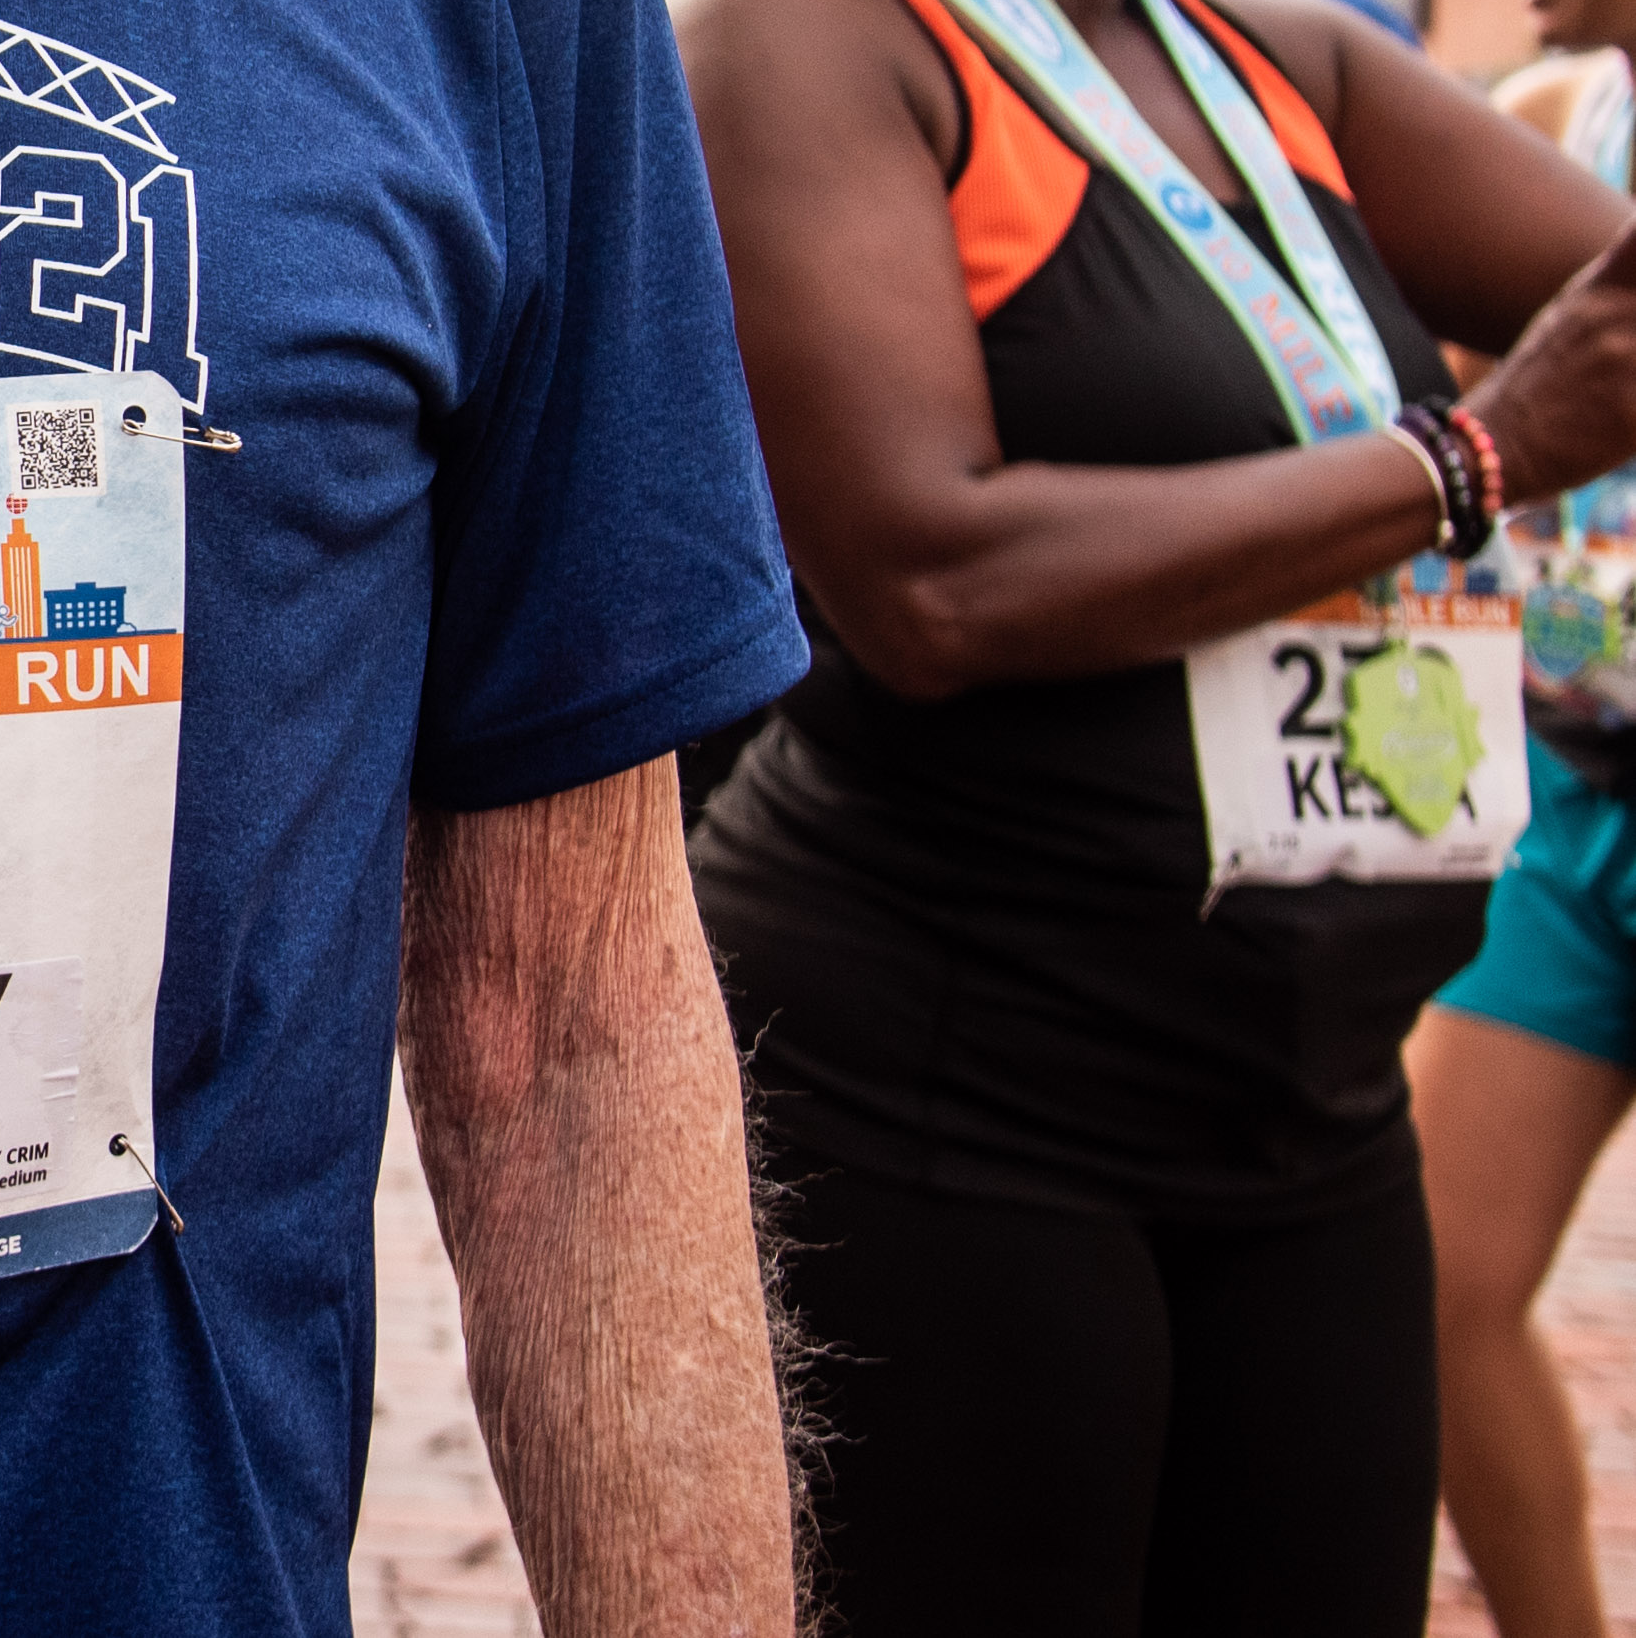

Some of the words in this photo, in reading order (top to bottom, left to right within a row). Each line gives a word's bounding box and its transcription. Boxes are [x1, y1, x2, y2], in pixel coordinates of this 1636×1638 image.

[1249, 292, 1355, 431] MILE
[17, 644, 150, 706] RUN
[6, 1142, 49, 1165] CRIM
